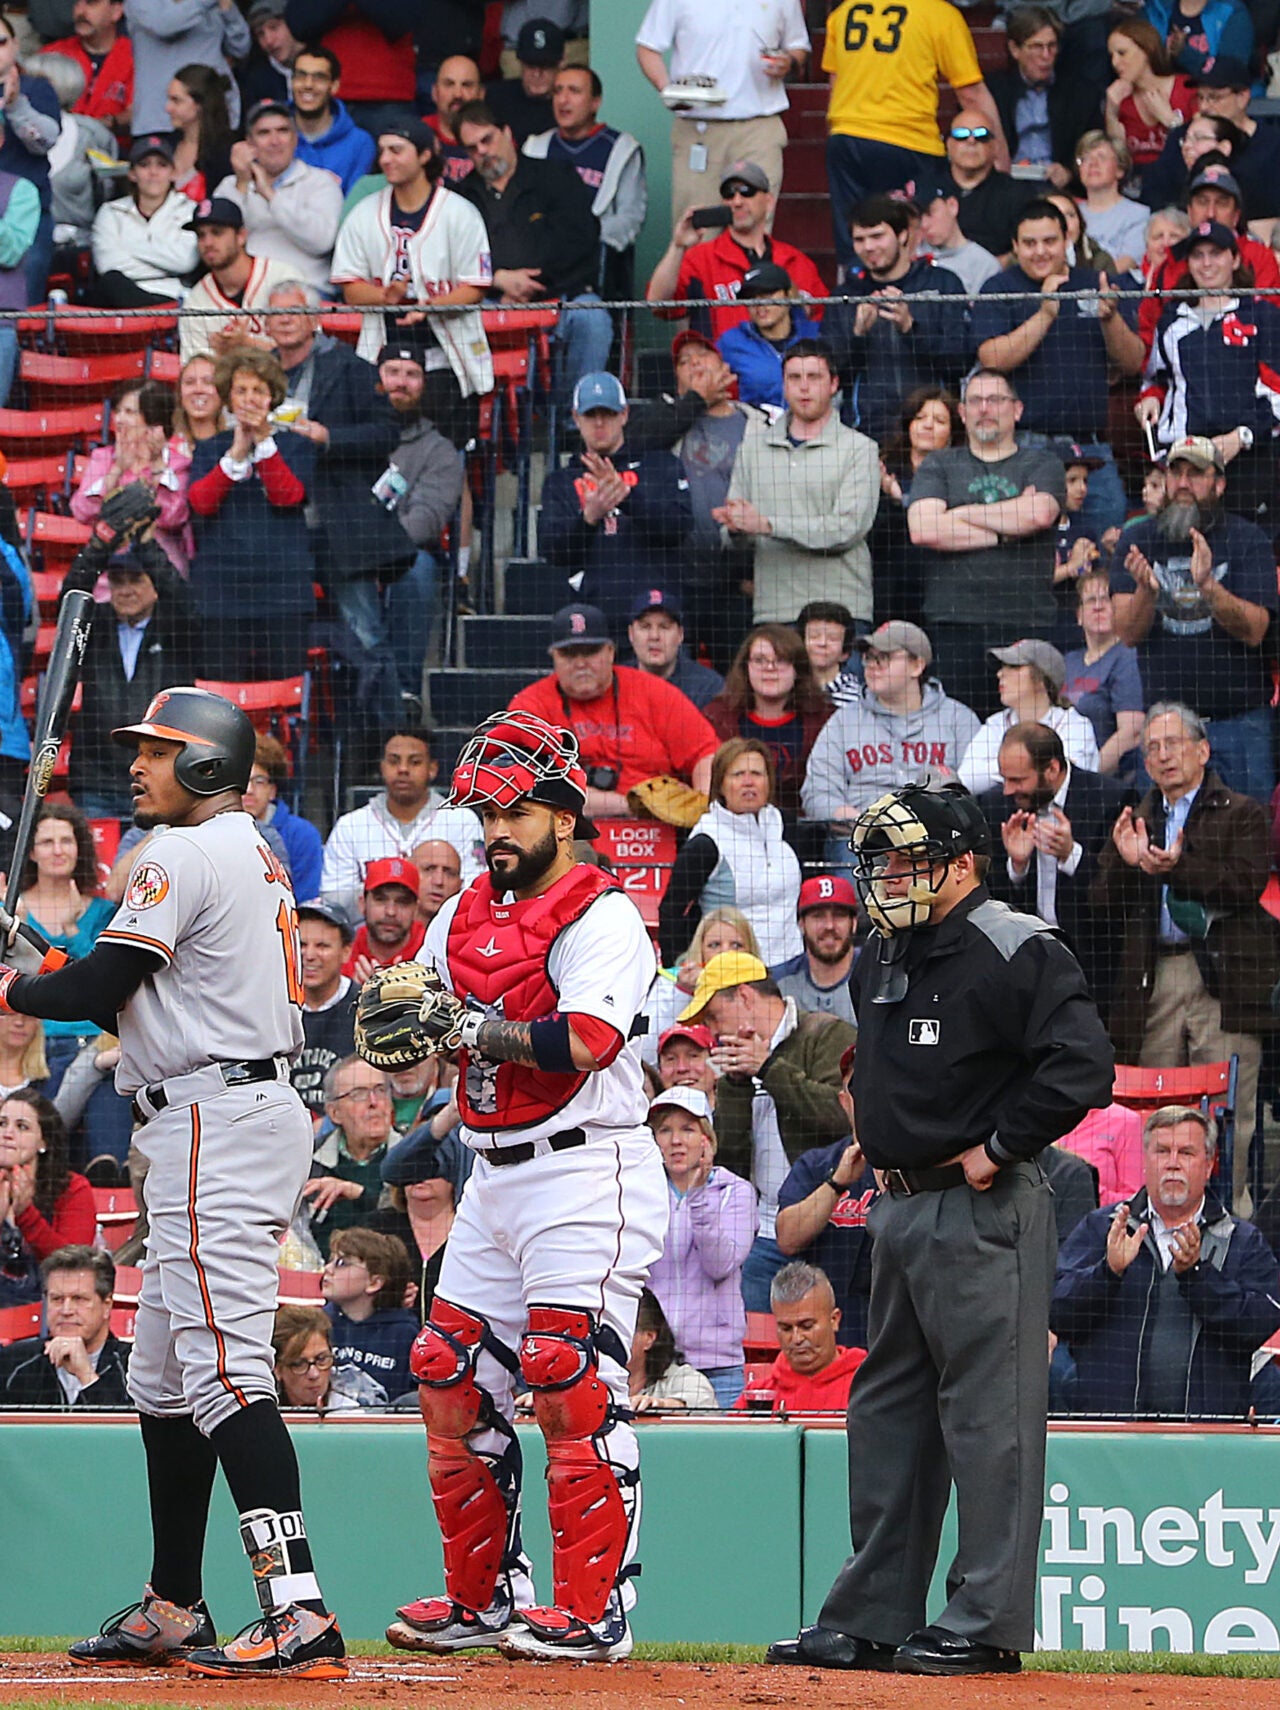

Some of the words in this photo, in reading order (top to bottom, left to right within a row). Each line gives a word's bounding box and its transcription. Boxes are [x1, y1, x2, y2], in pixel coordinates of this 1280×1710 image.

[845, 4, 908, 54] 63
[846, 742, 948, 774] BOSTON
[609, 827, 662, 843] LOGE
[616, 842, 656, 857] BOX
[818, 878, 835, 898] B
[1043, 1483, 1280, 1584] inety
